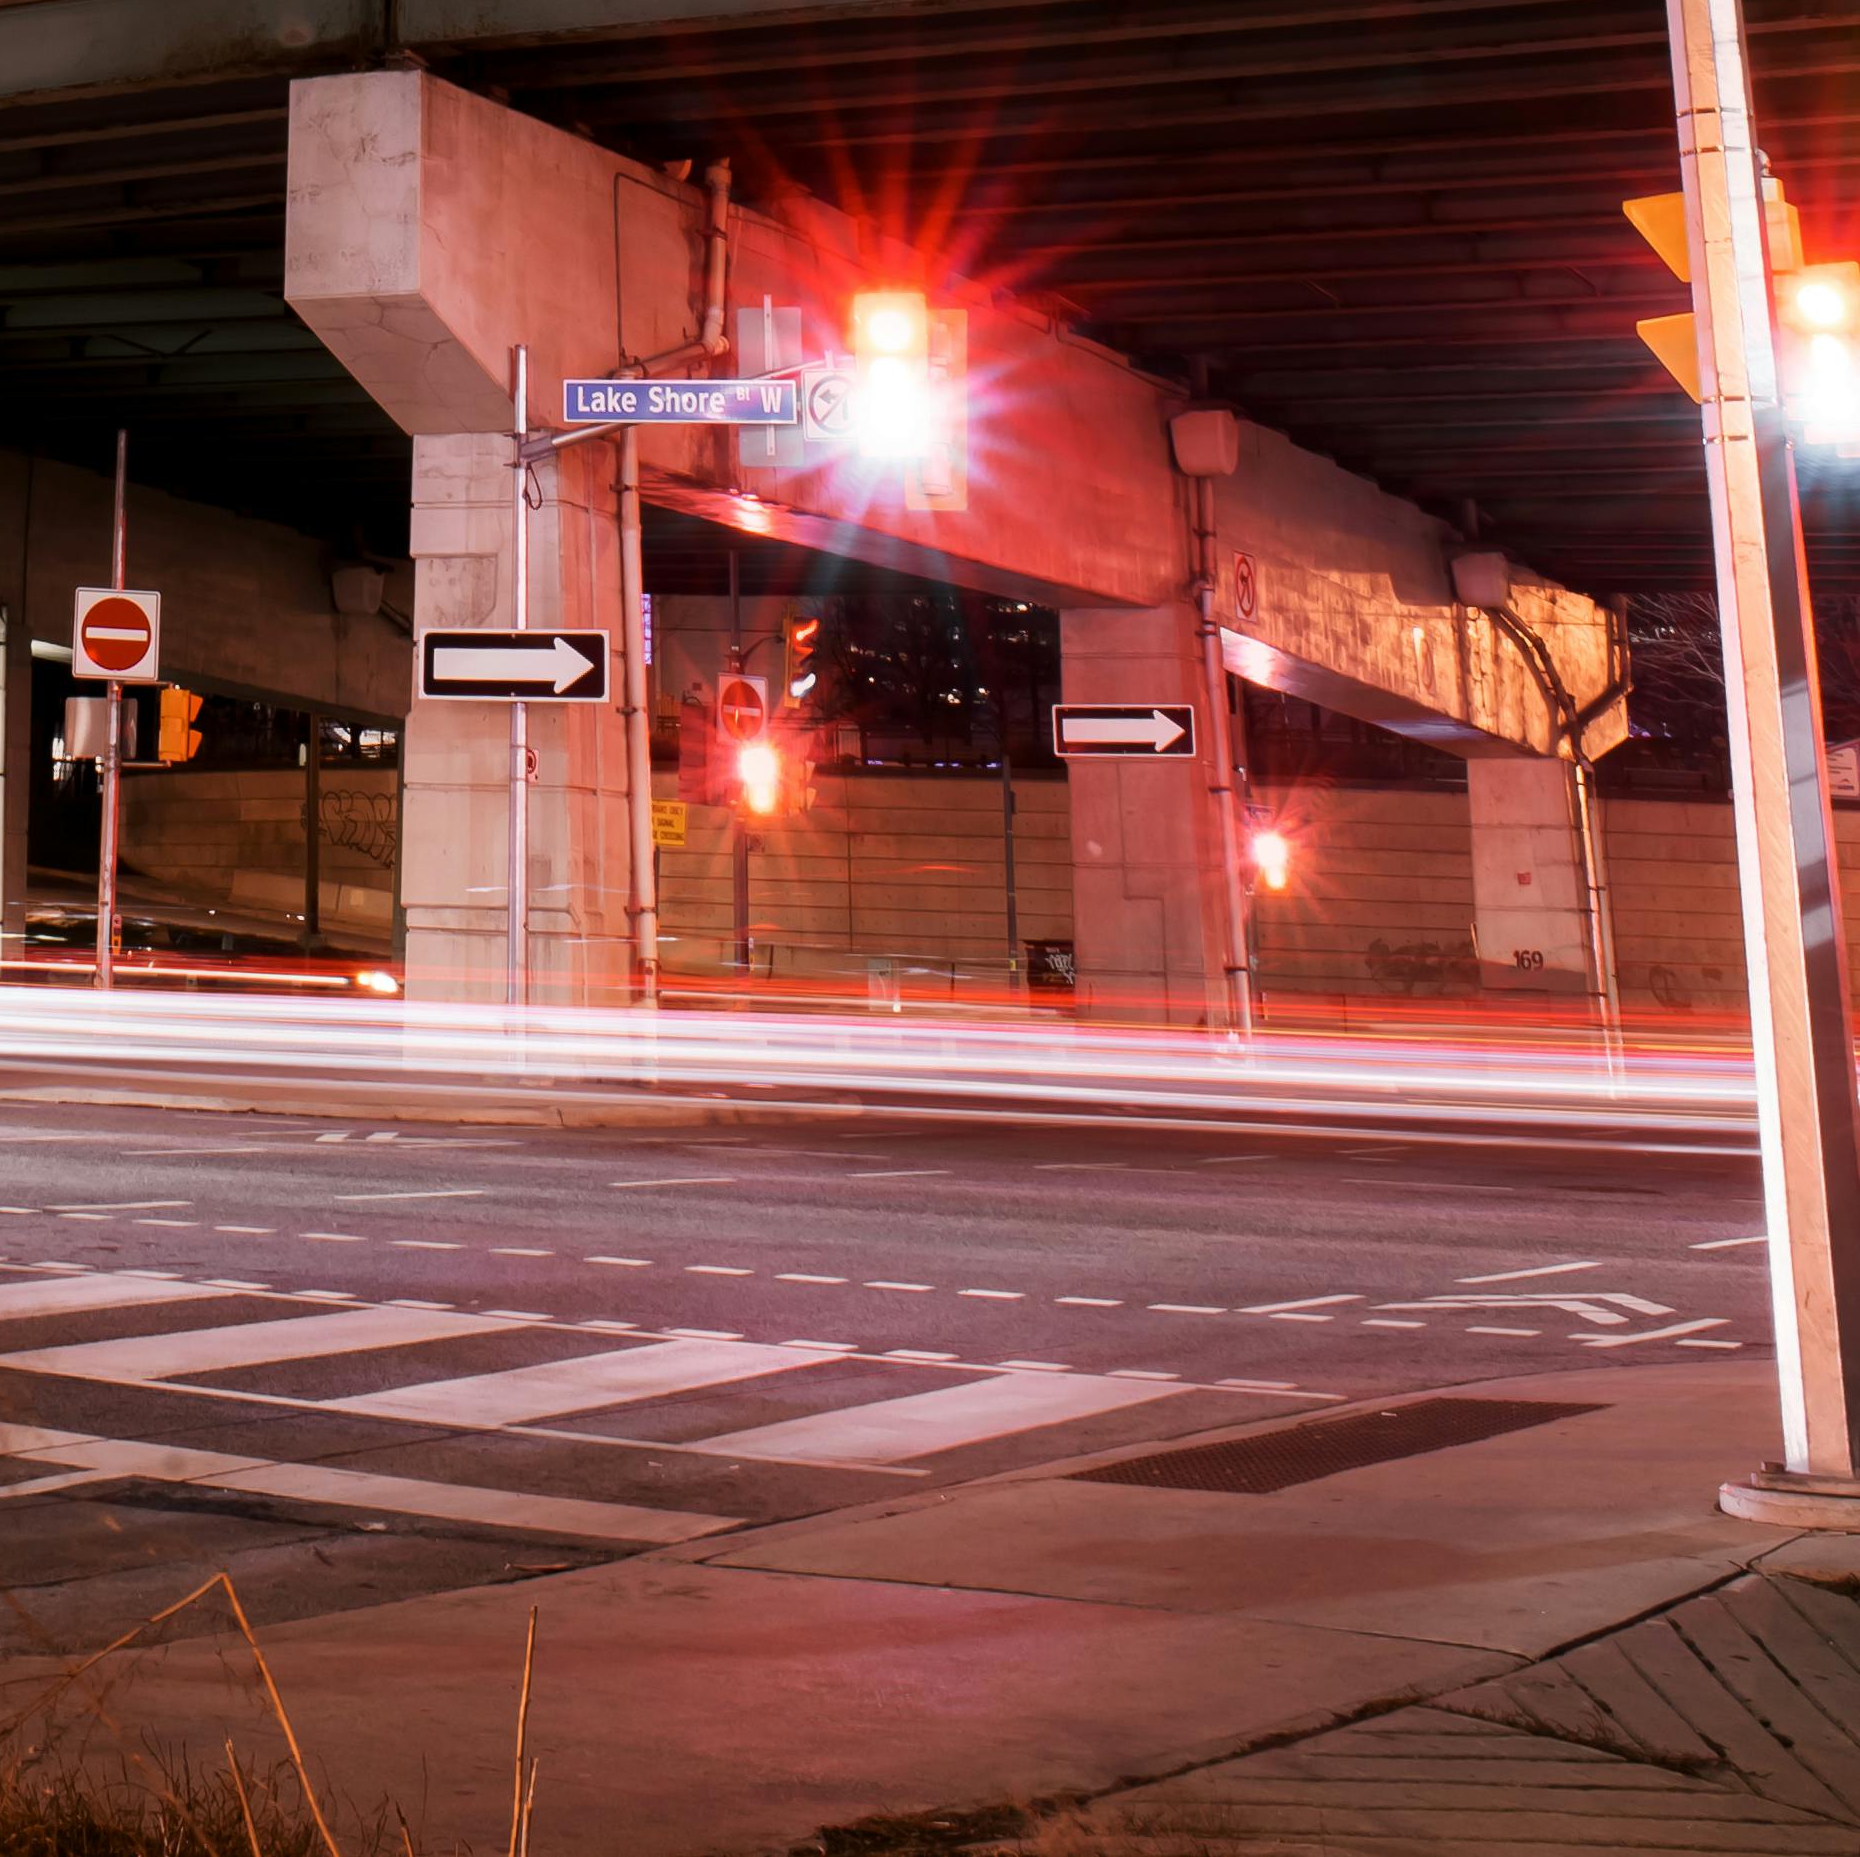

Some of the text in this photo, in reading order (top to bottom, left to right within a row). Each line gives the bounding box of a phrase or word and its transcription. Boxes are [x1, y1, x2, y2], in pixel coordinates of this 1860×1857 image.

[577, 386, 637, 413] Lake
[648, 386, 726, 413] Shore
[760, 386, 783, 414] W
[1512, 949, 1544, 973] 169
